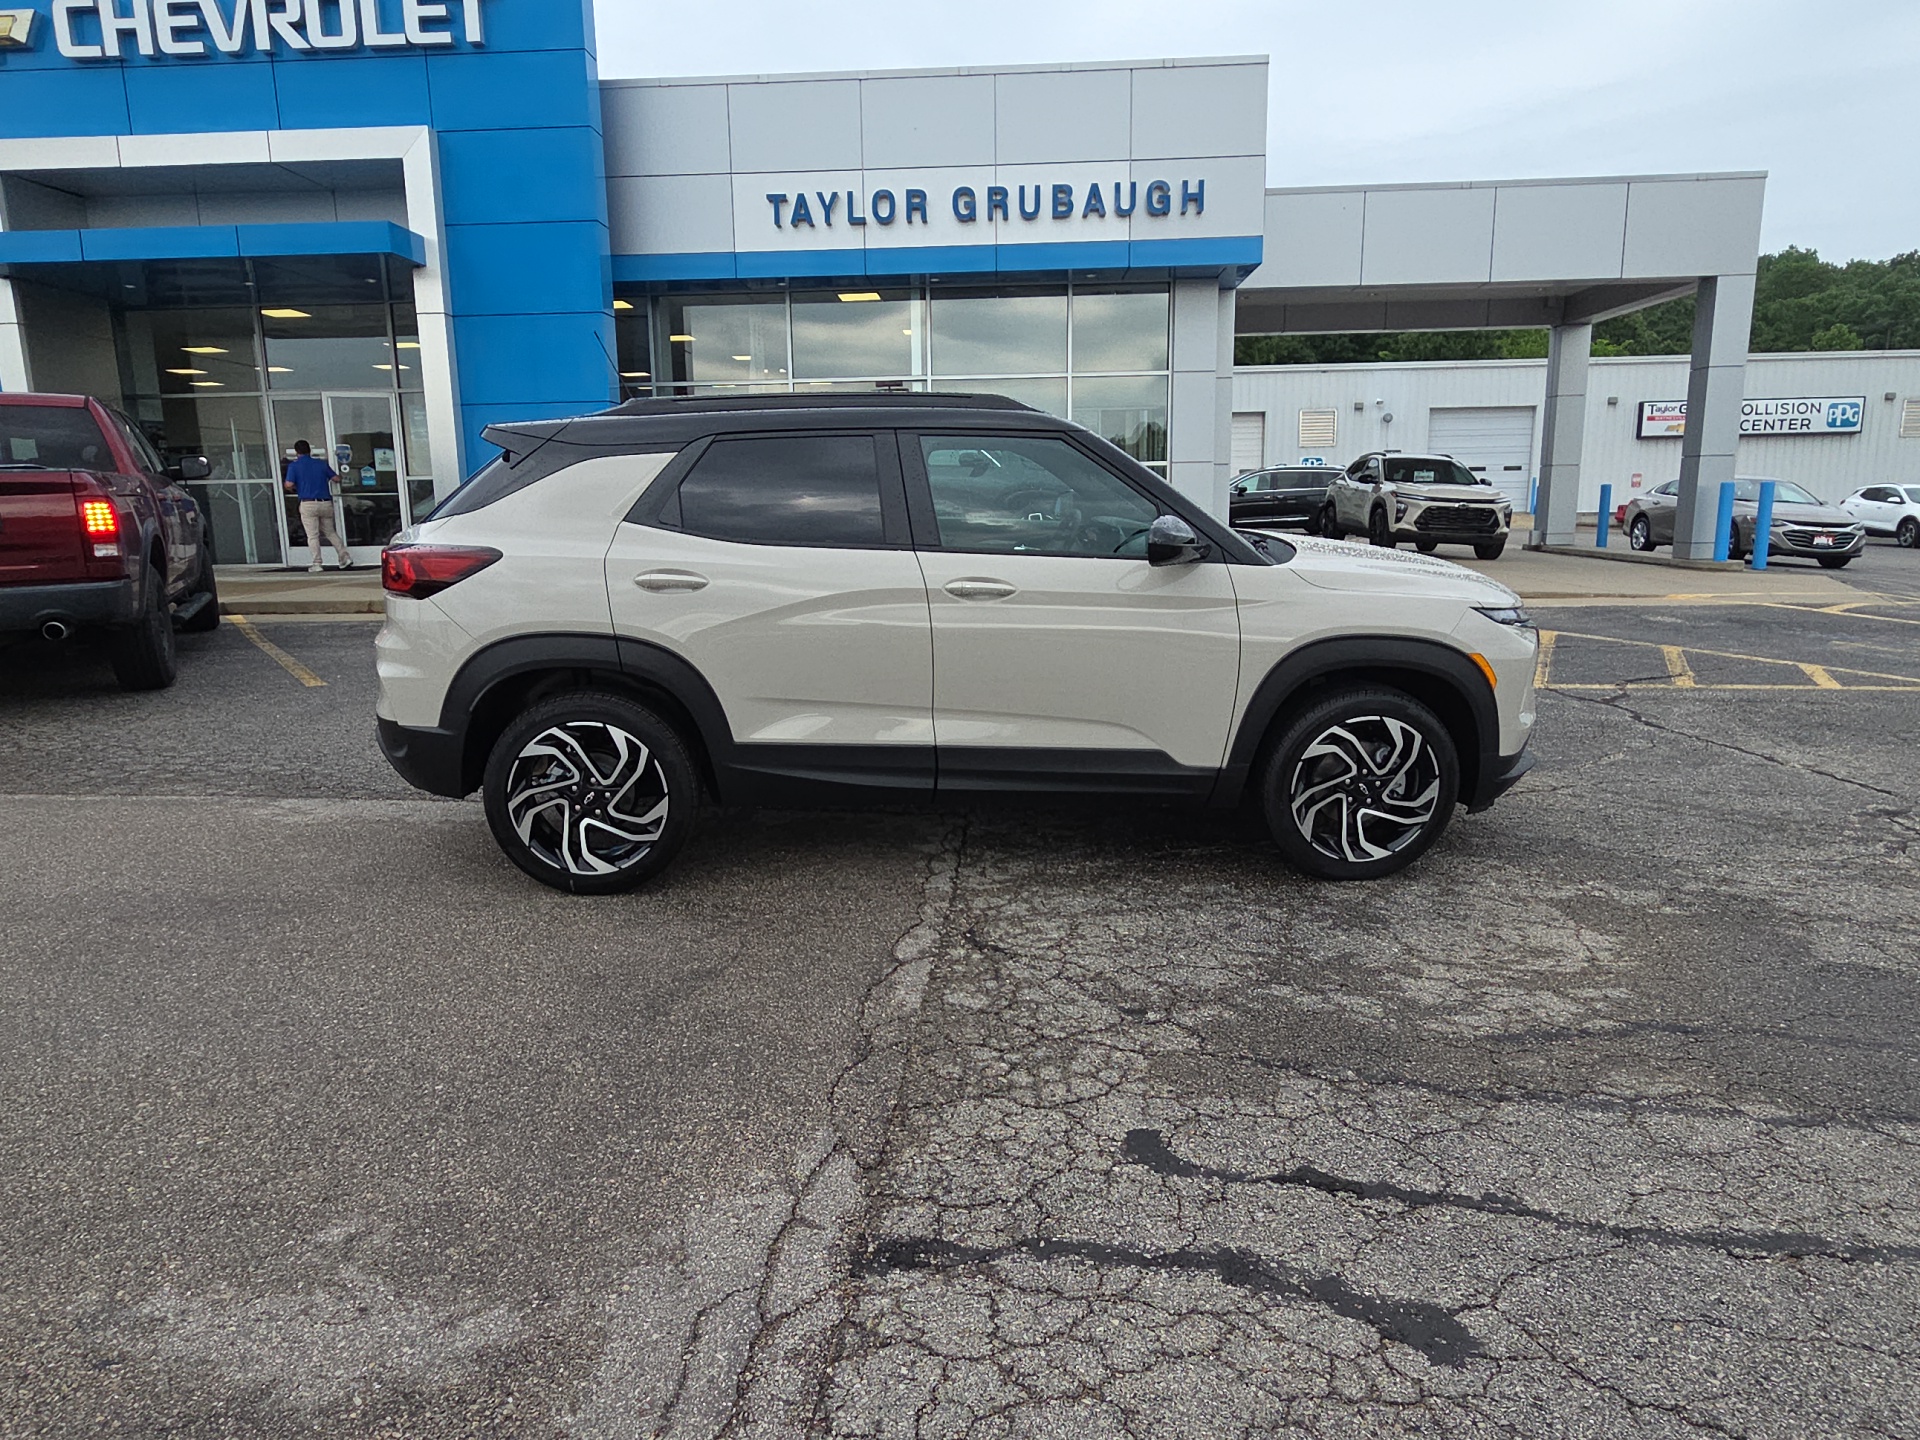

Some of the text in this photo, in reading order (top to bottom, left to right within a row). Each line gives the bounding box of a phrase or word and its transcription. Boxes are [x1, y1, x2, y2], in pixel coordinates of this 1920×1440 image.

[52, 0, 482, 57] CHEVROLET
[766, 179, 1205, 228] TAYLOR GRUBAUGH
[1648, 404, 1678, 414] Taylor
[1741, 402, 1822, 416] OLLISION
[1740, 418, 1812, 432] CENTER
